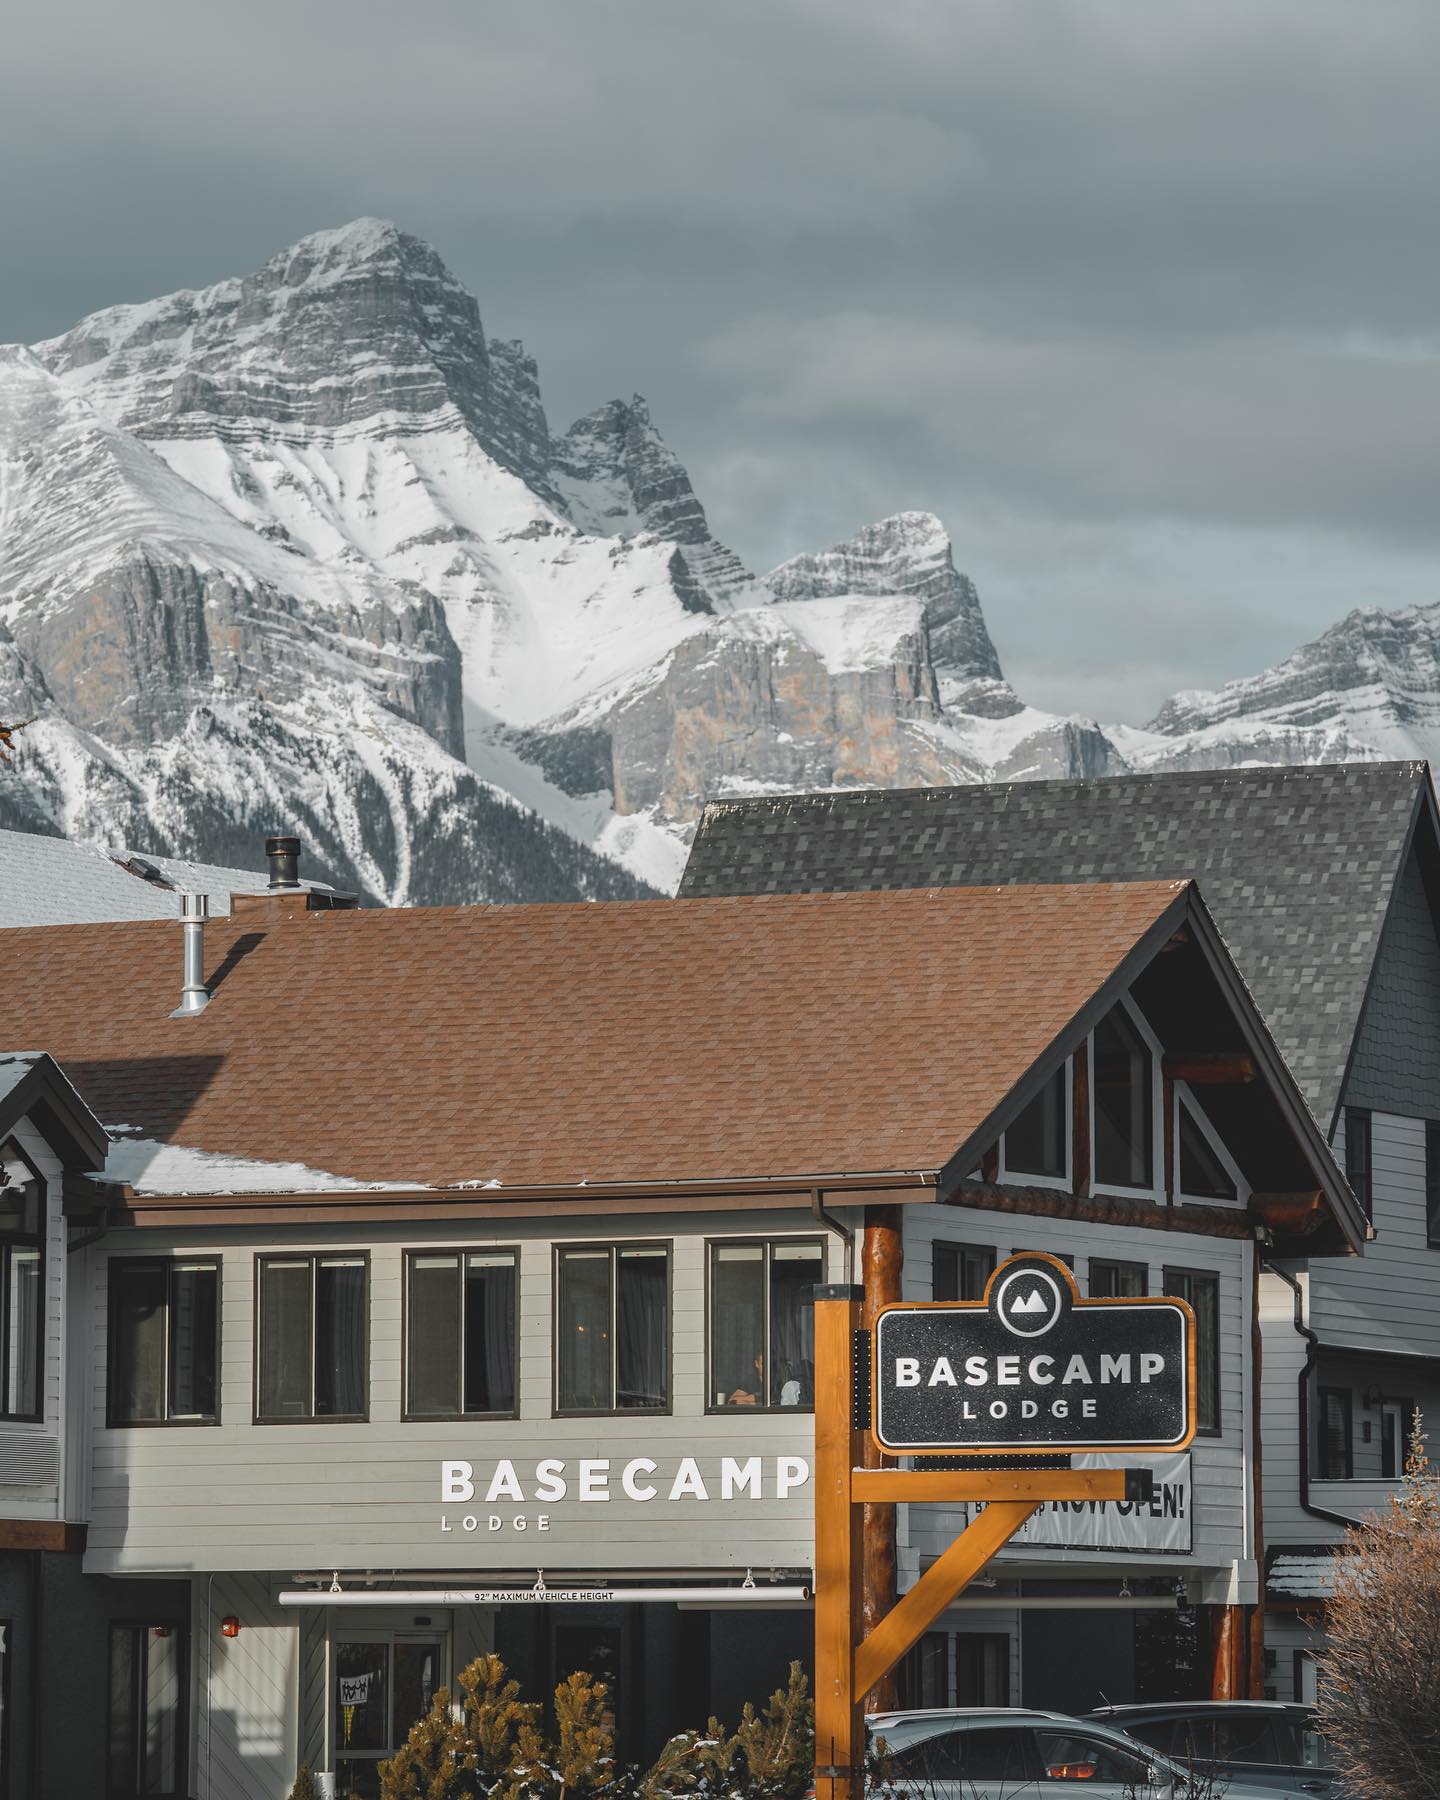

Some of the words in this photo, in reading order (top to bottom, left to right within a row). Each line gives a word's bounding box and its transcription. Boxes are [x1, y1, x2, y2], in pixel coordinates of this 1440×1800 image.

[895, 1353, 1166, 1388] BASECAMP
[962, 1399, 1098, 1420] LODGE
[441, 1456, 810, 1503] BASECAMP
[441, 1515, 551, 1532] LODGE
[492, 1592, 536, 1601] MAXIMUM
[538, 1592, 577, 1601] VEHICLE
[580, 1592, 614, 1600] HEIGHT
